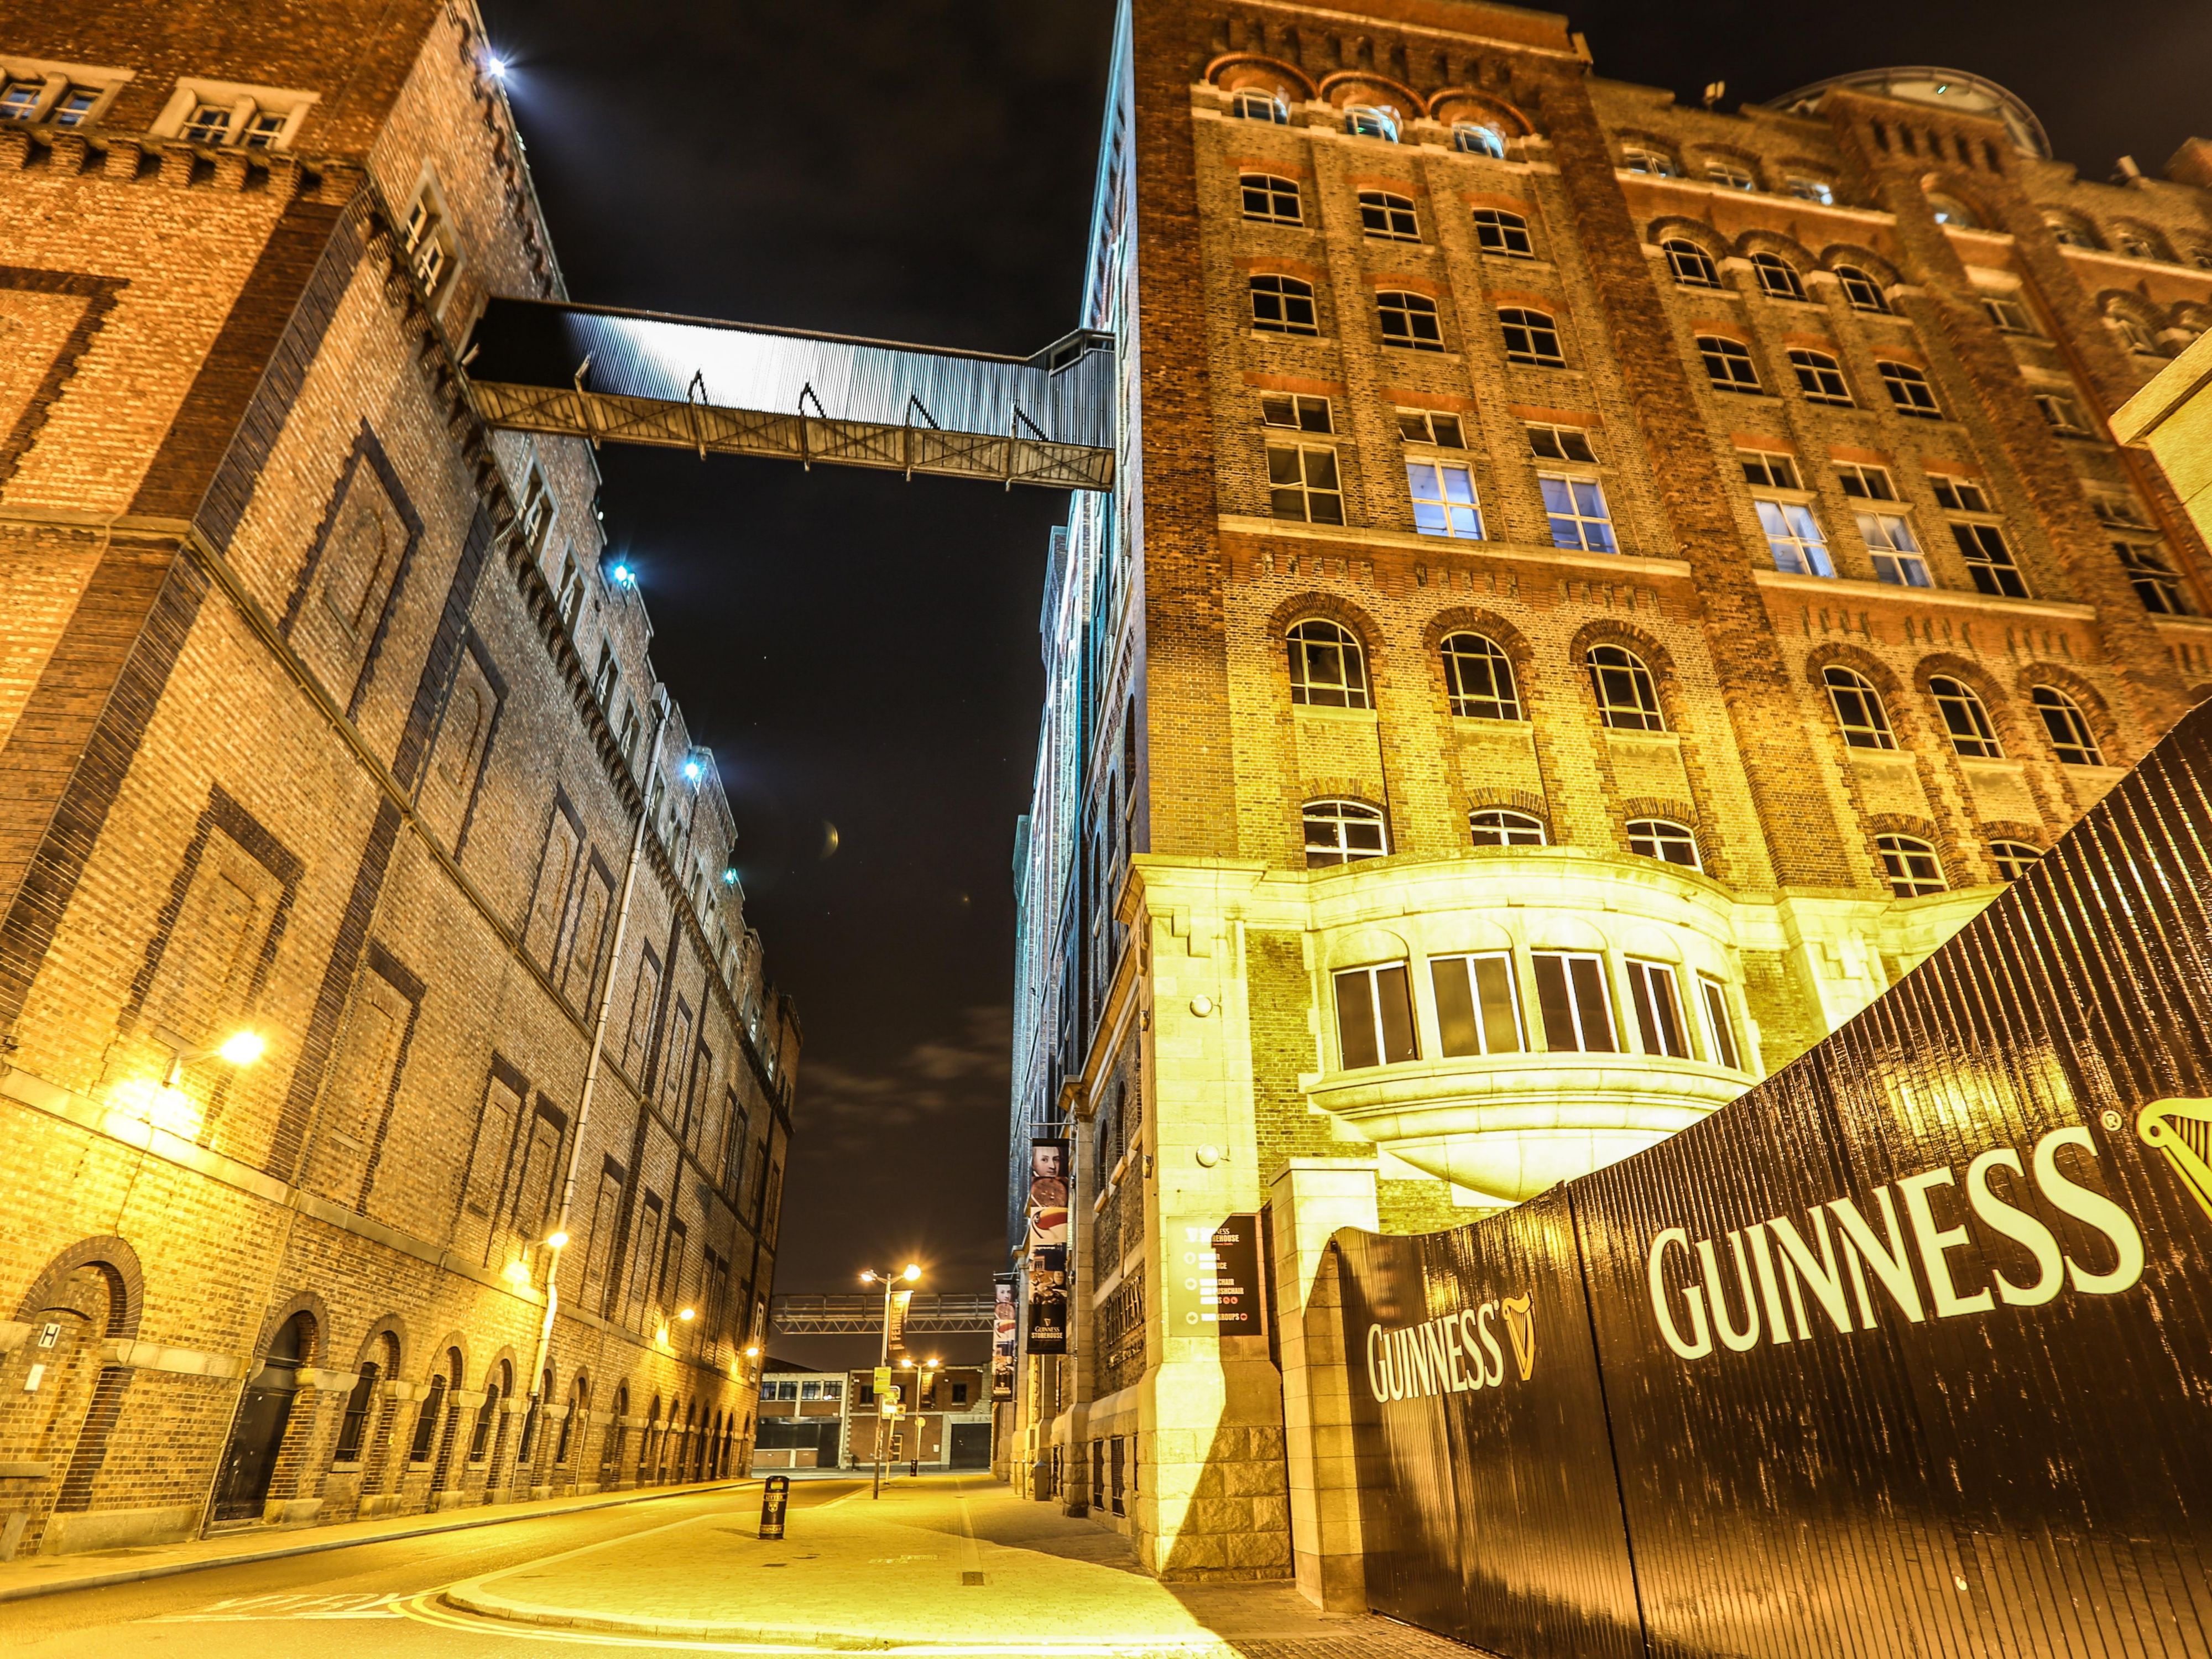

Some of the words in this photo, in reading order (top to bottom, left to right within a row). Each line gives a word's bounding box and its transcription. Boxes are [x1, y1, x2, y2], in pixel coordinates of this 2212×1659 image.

[1649, 1126, 2146, 1360] GUINNESS
[41, 1326, 59, 1346] H
[1366, 1303, 1505, 1403] GUINNESS
